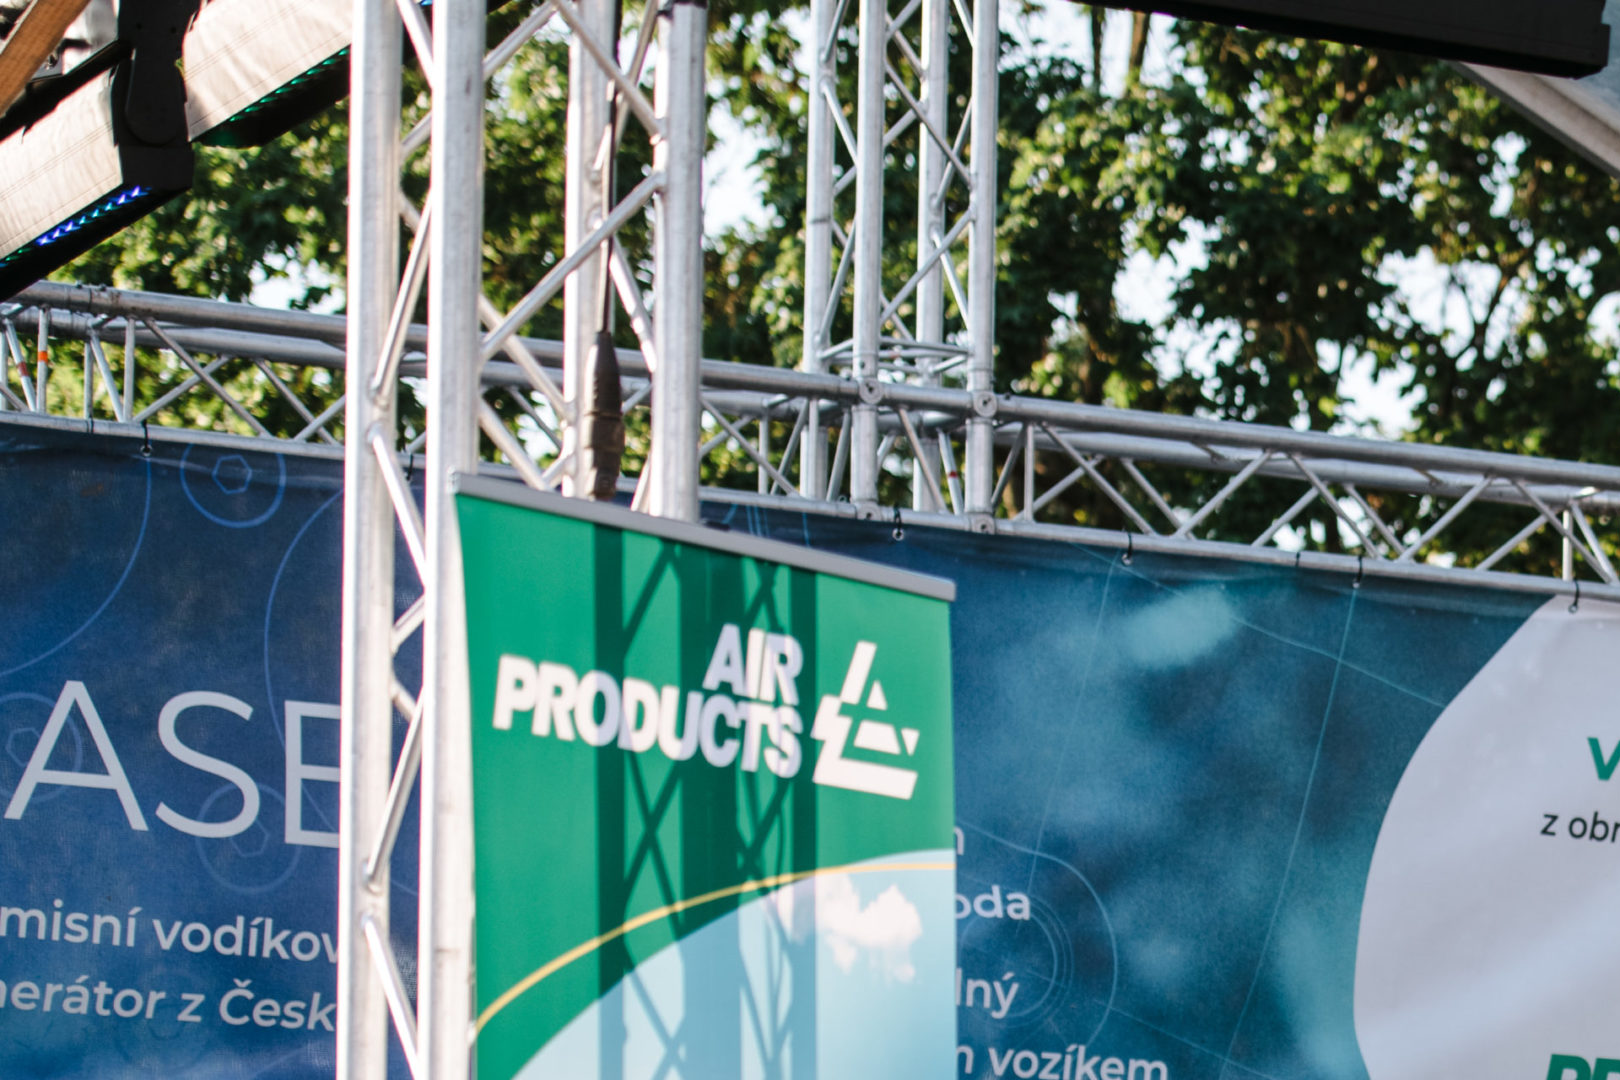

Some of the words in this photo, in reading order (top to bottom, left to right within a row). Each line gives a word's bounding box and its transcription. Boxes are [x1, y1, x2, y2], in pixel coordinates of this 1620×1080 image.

[702, 623, 803, 706] AIR
[492, 653, 804, 779] PRODUCTS
[1540, 813, 1560, 837] z
[0, 898, 144, 948] misní
[177, 992, 204, 1024] z
